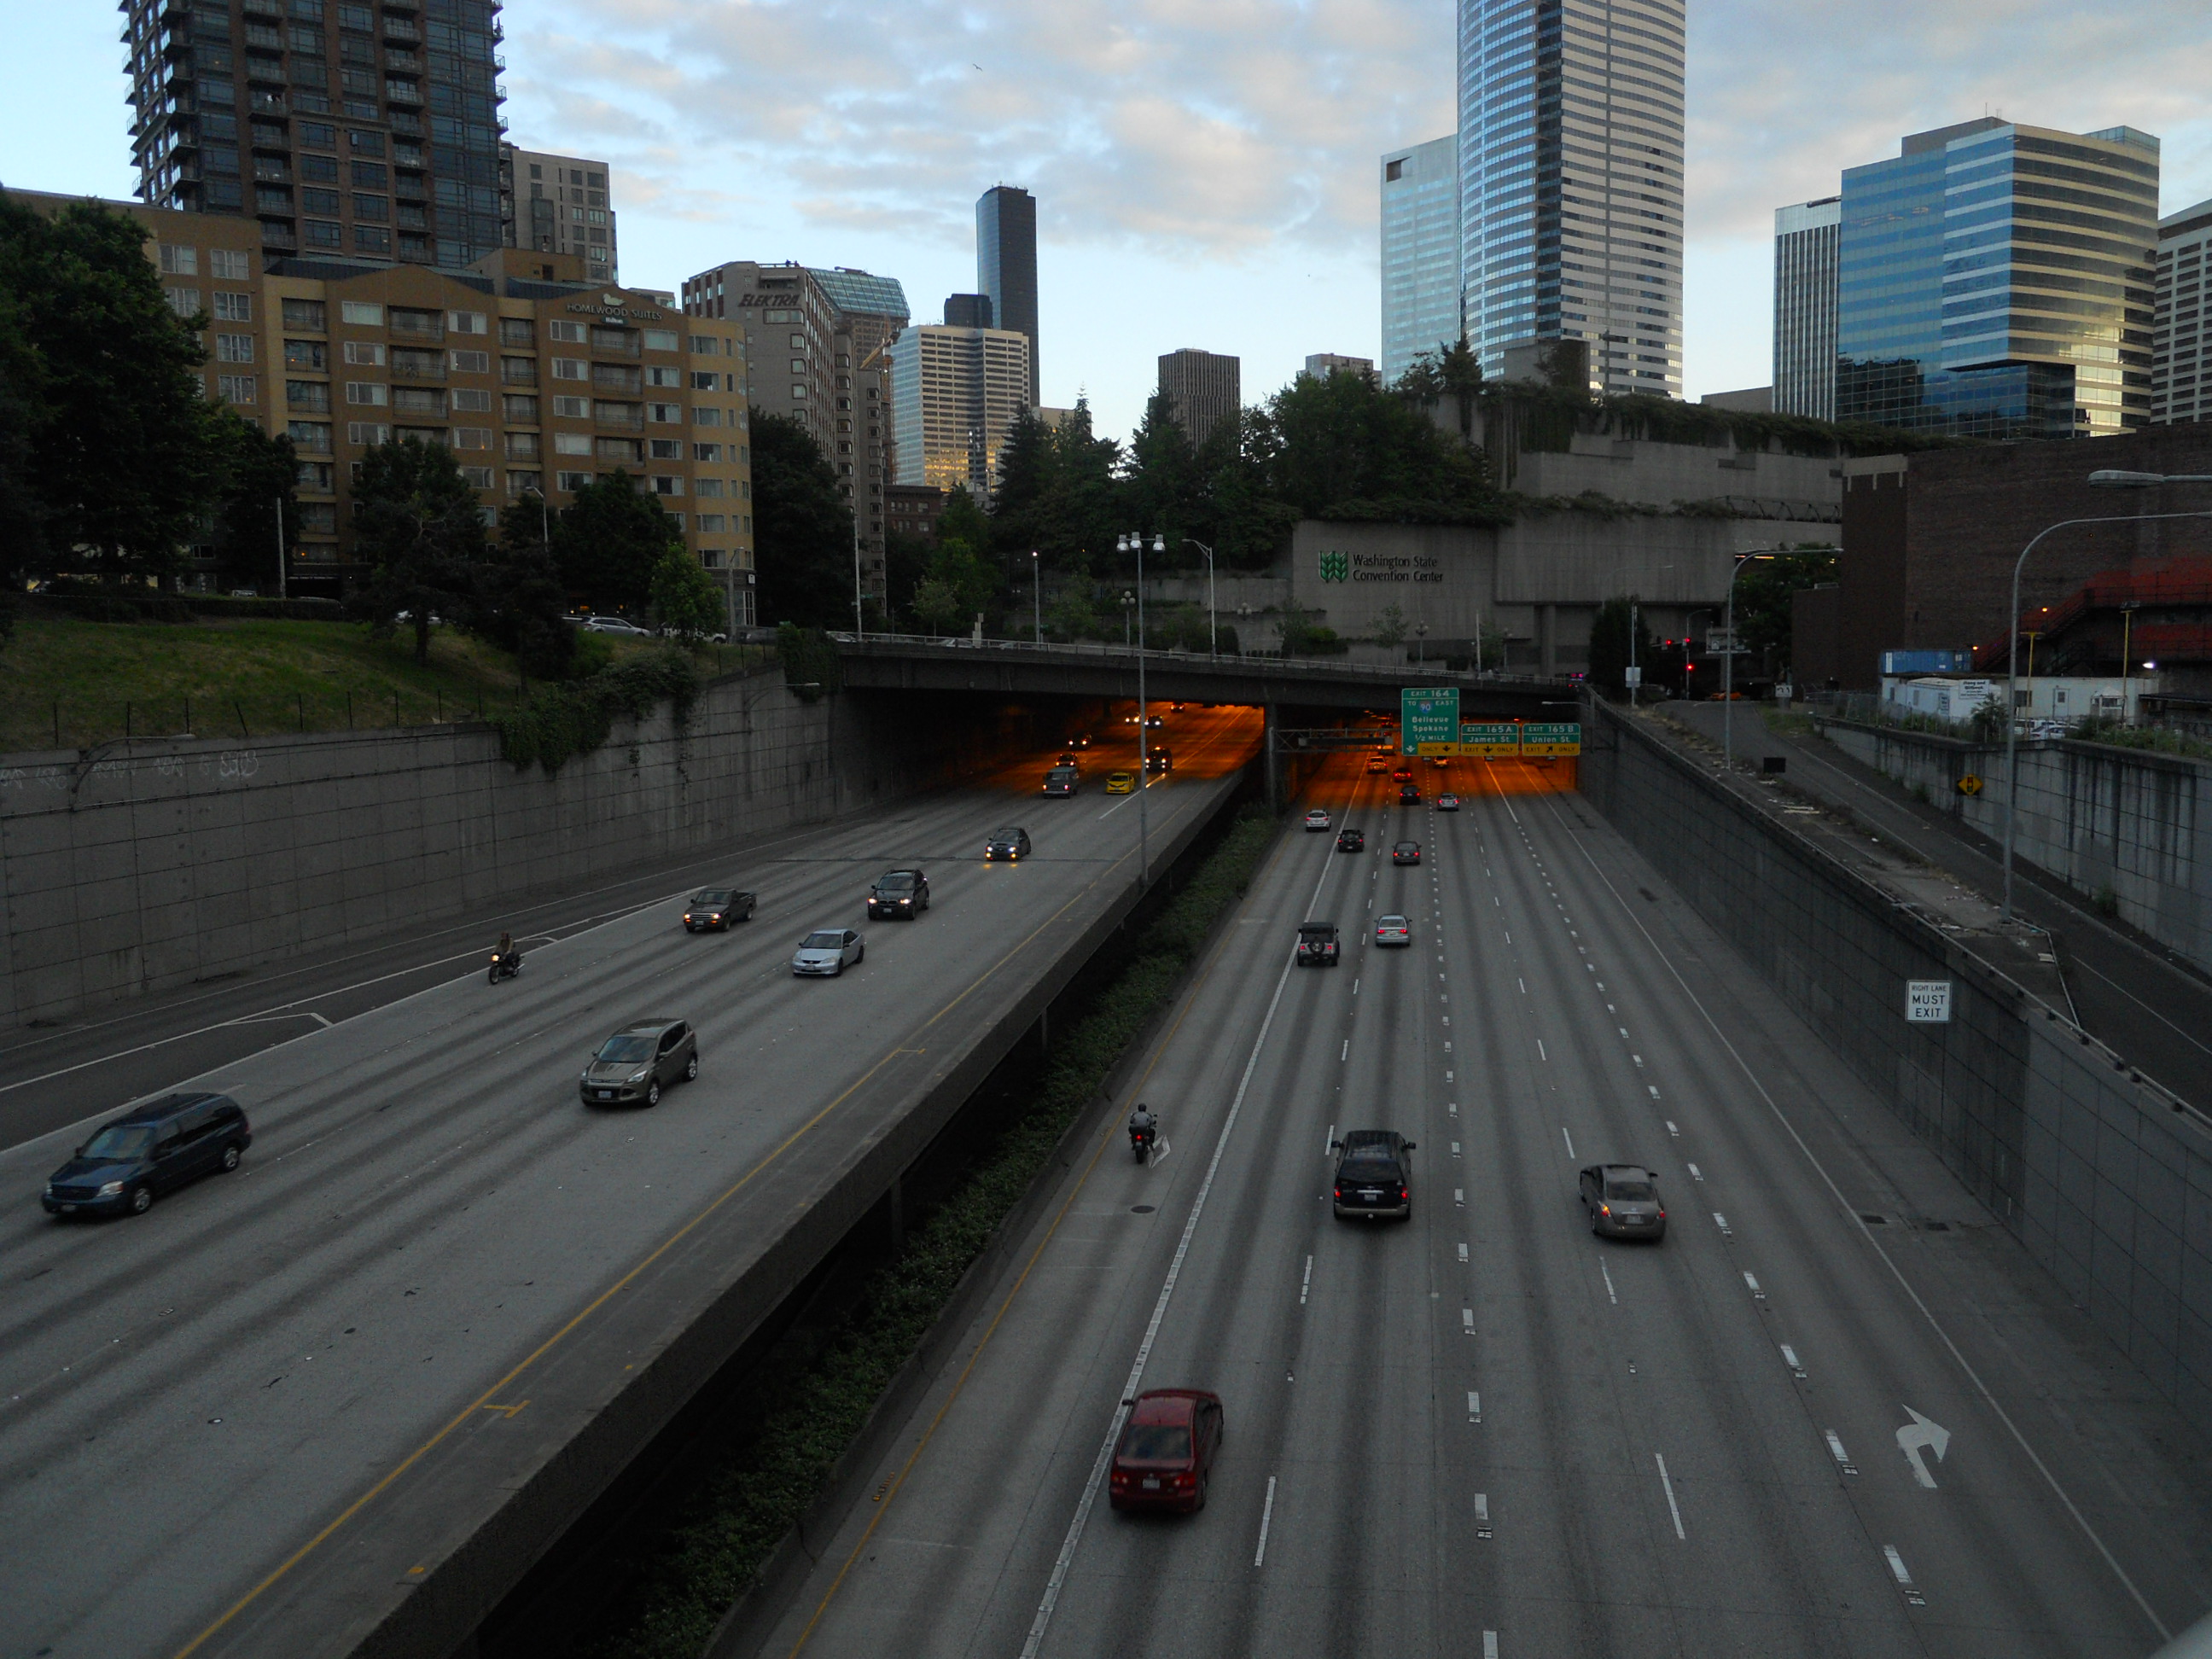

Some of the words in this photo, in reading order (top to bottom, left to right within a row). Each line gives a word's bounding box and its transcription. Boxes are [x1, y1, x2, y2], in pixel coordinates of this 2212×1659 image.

[737, 294, 800, 307] ELEKTRA
[567, 303, 629, 317] HOMEWOOD
[631, 309, 662, 320] SUITES
[1353, 554, 1410, 569] Washington
[1413, 556, 1437, 568] State
[1353, 569, 1409, 581] Convention
[1413, 571, 1443, 582] Center
[1420, 703, 1431, 712] 90
[1412, 725, 1448, 733] Spokane
[1912, 994, 1945, 1004] MUST
[1916, 1008, 1941, 1017] EXIT
